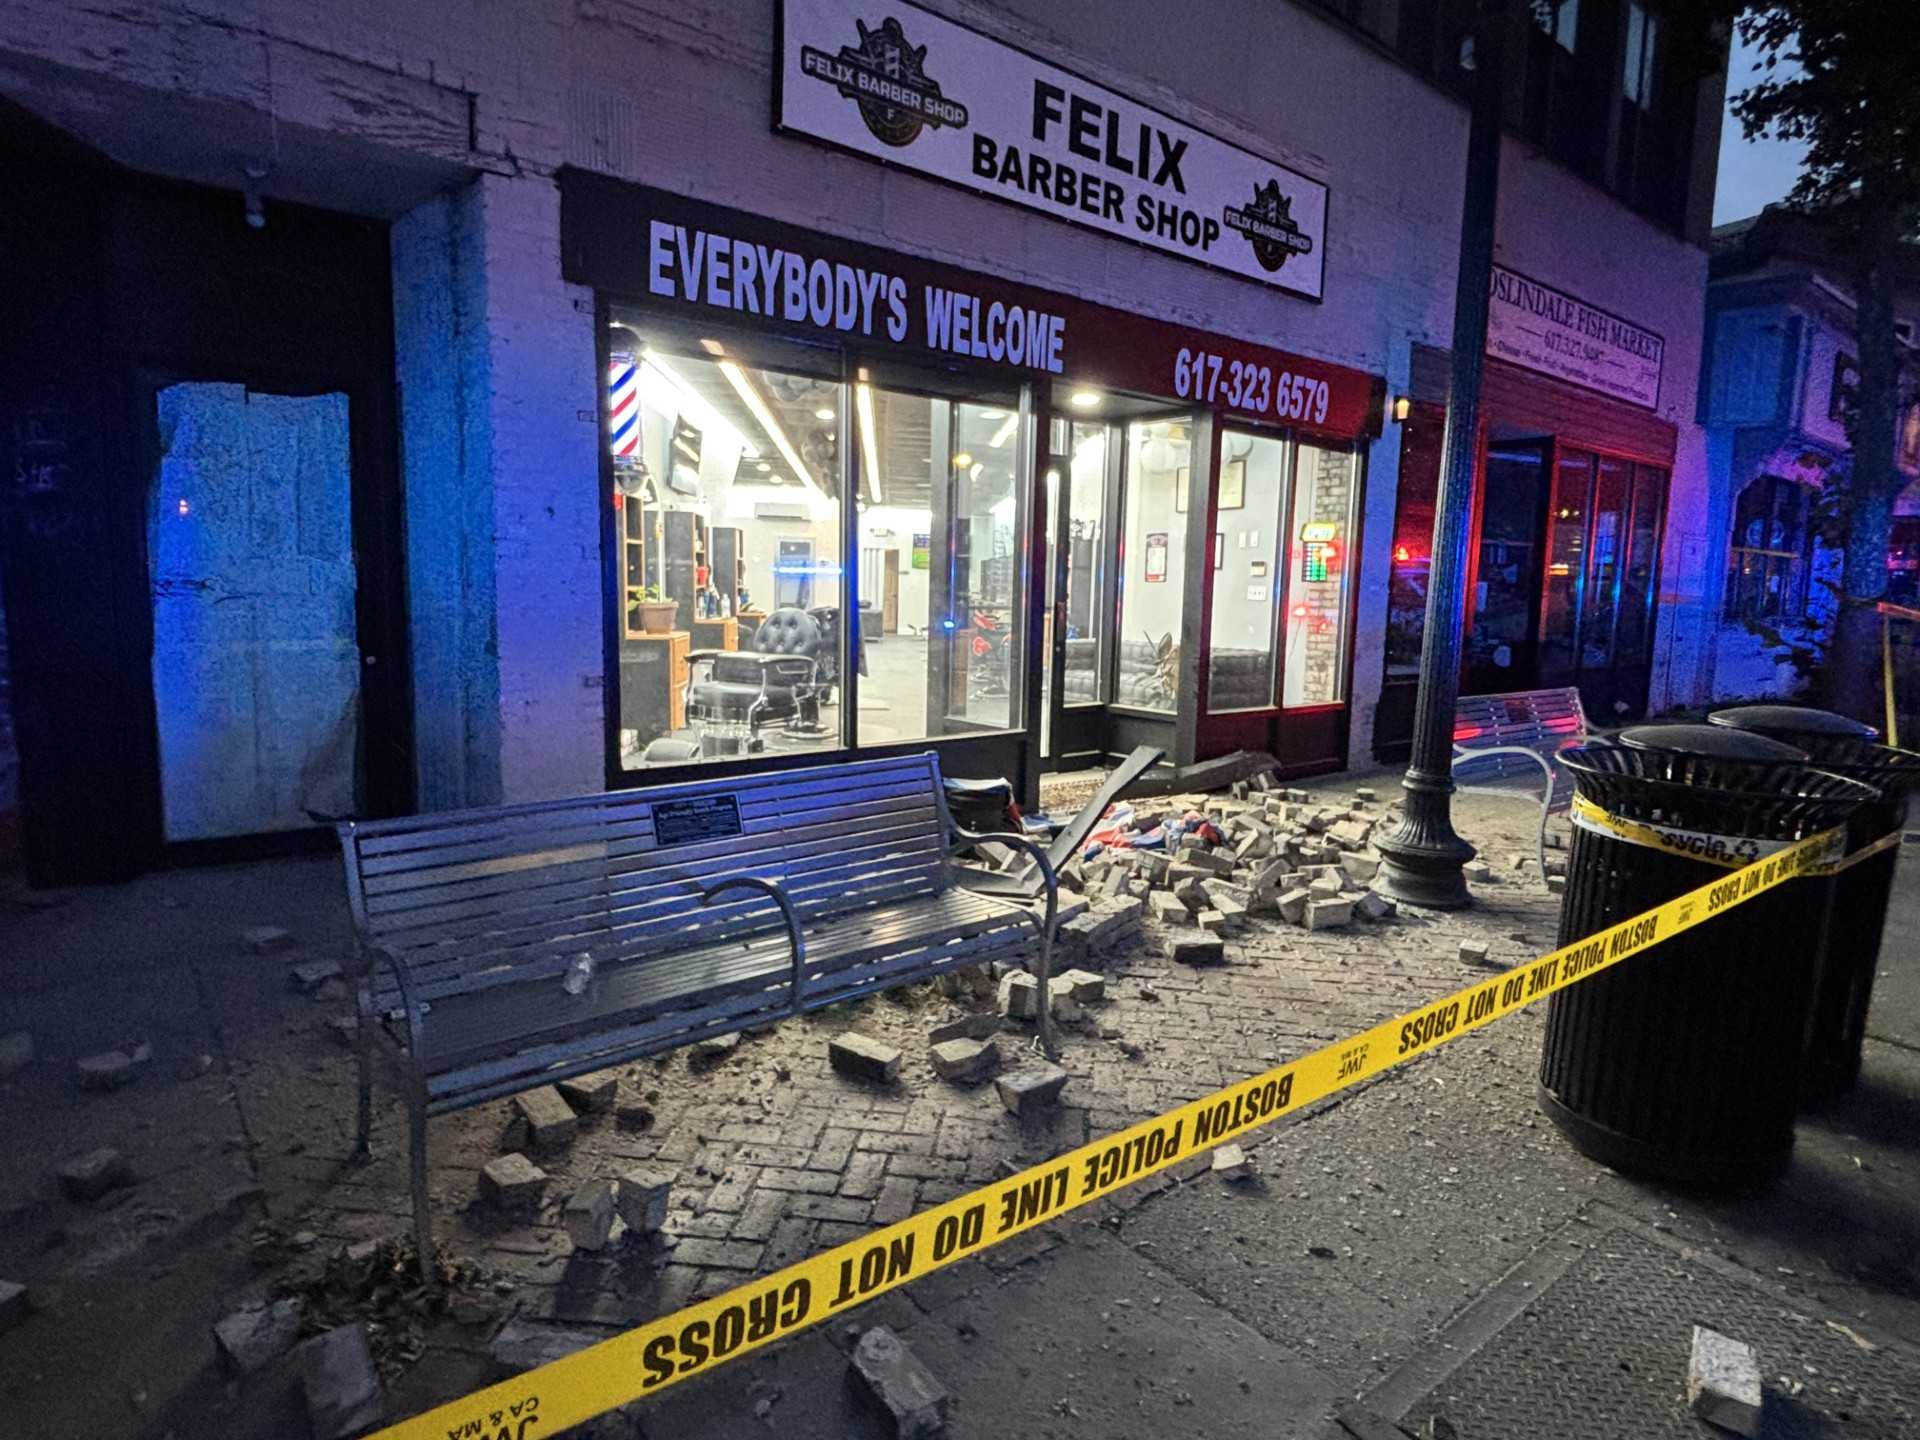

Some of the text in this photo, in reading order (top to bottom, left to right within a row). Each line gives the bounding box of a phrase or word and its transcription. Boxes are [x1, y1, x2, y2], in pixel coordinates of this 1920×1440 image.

[804, 53, 966, 123] FELIX BARBER SHOP
[1032, 79, 1190, 194] FELIX
[972, 132, 1220, 253] BARBER SHOP
[649, 219, 1066, 374] EVERYBODY'S WELCOME
[1577, 306, 1607, 343] FISH
[1174, 347, 1329, 425] 617-323 6579
[1708, 876, 1741, 911] CROSS
[1741, 867, 1762, 896] NOT
[1610, 914, 1658, 959] BOSTON
[1528, 959, 1559, 996] LINE
[1562, 937, 1608, 981] POLICE
[1463, 986, 1498, 1026] NOT
[1502, 973, 1525, 1010] DO
[1398, 1002, 1460, 1056] CROSS
[642, 1073, 1295, 1389] BOSTON POLICE LINE DO NOT CROSS
[447, 1419, 482, 1440] MA
[510, 1397, 539, 1418] CA
